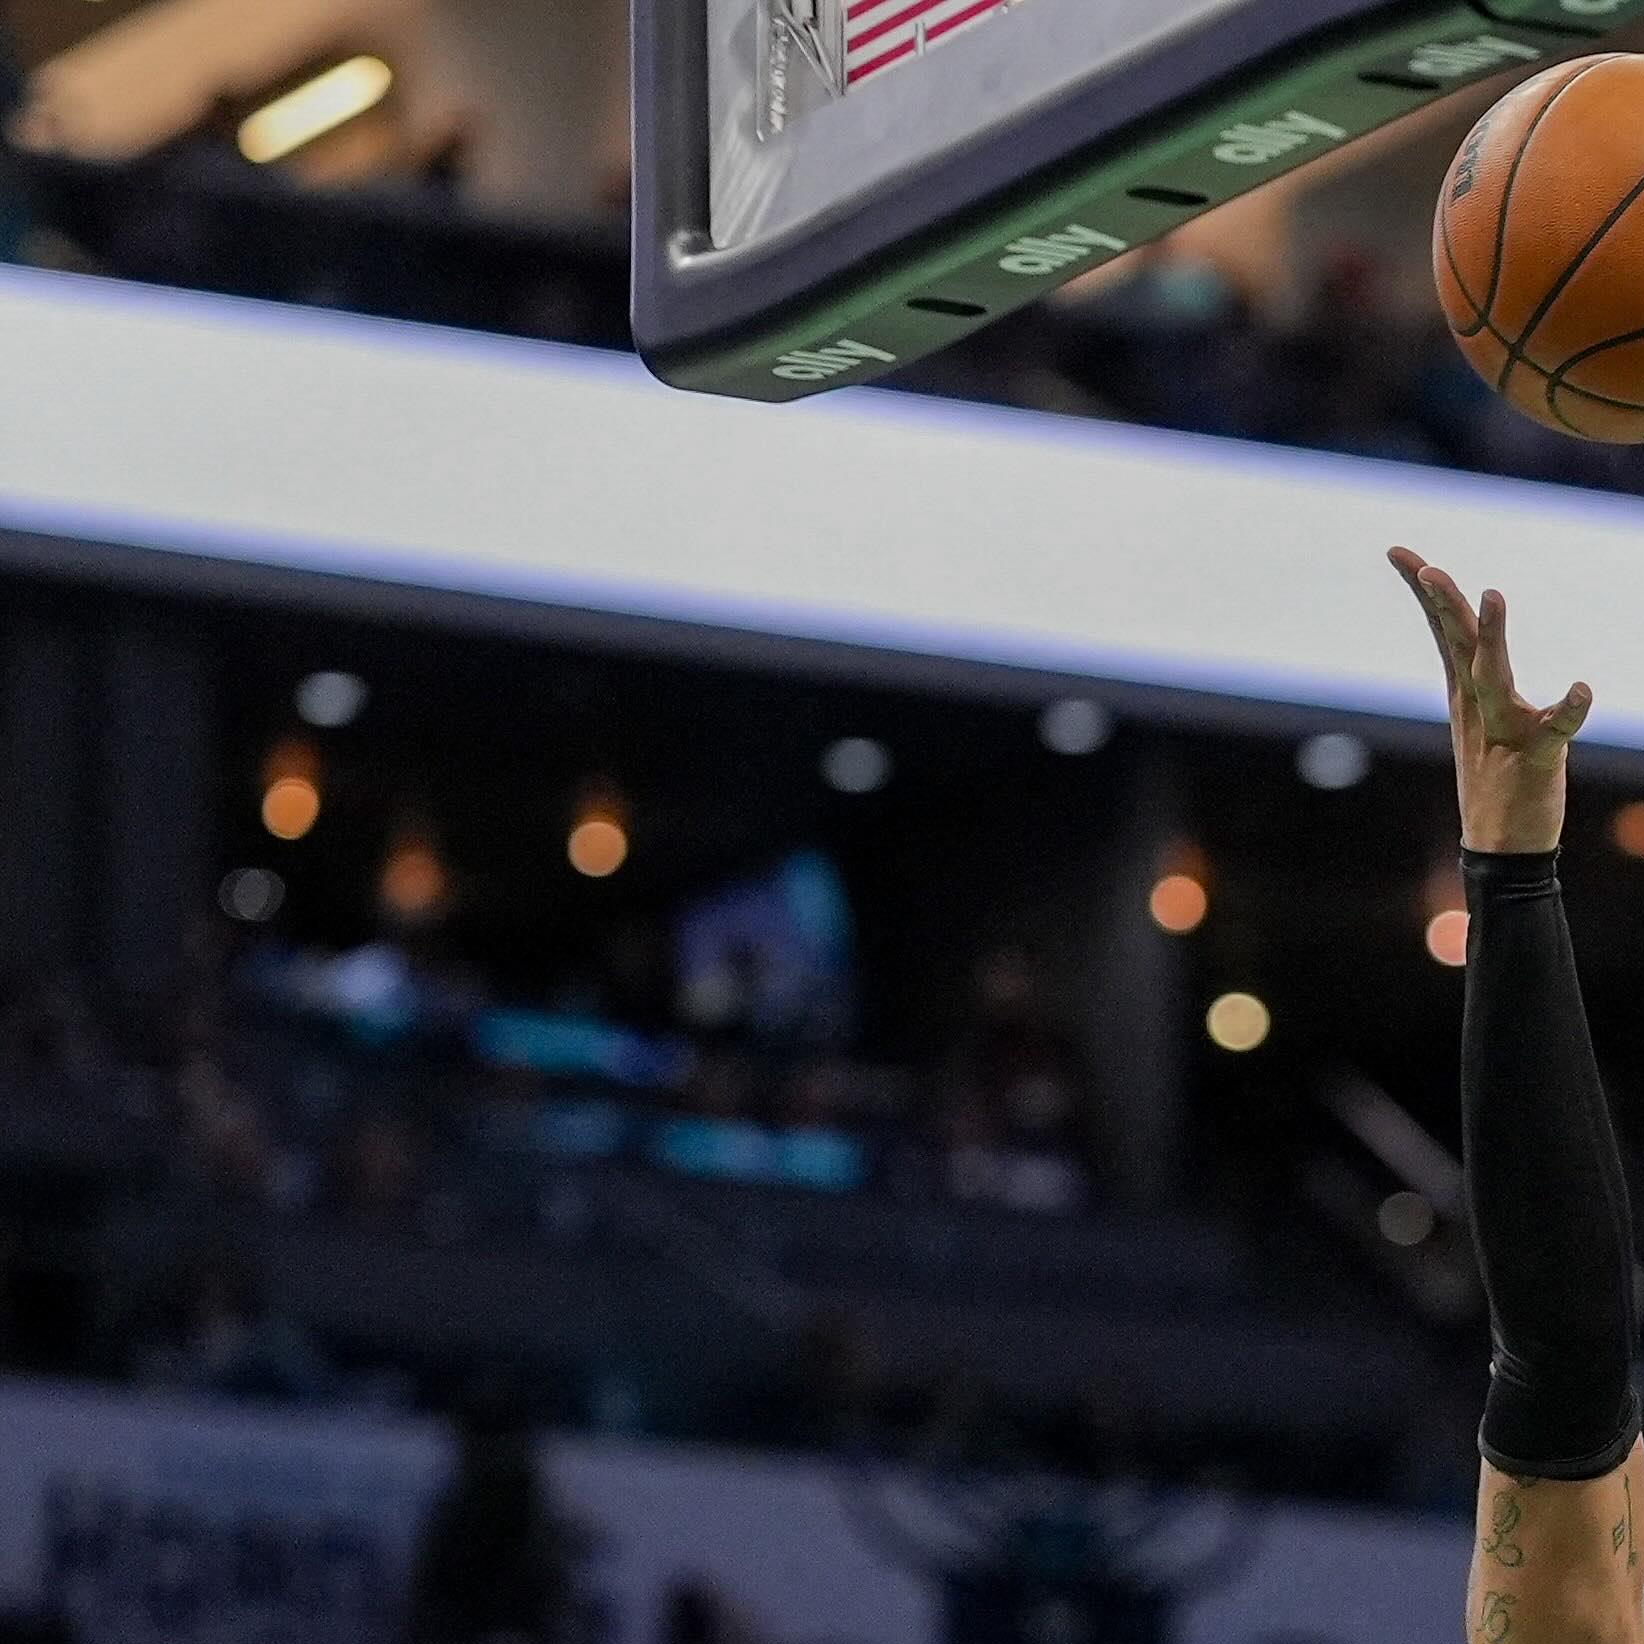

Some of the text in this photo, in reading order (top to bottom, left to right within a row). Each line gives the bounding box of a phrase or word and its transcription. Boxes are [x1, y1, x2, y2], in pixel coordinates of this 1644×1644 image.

[1212, 110, 1347, 164] ally
[998, 224, 1128, 275] ally
[771, 338, 897, 380] ally
